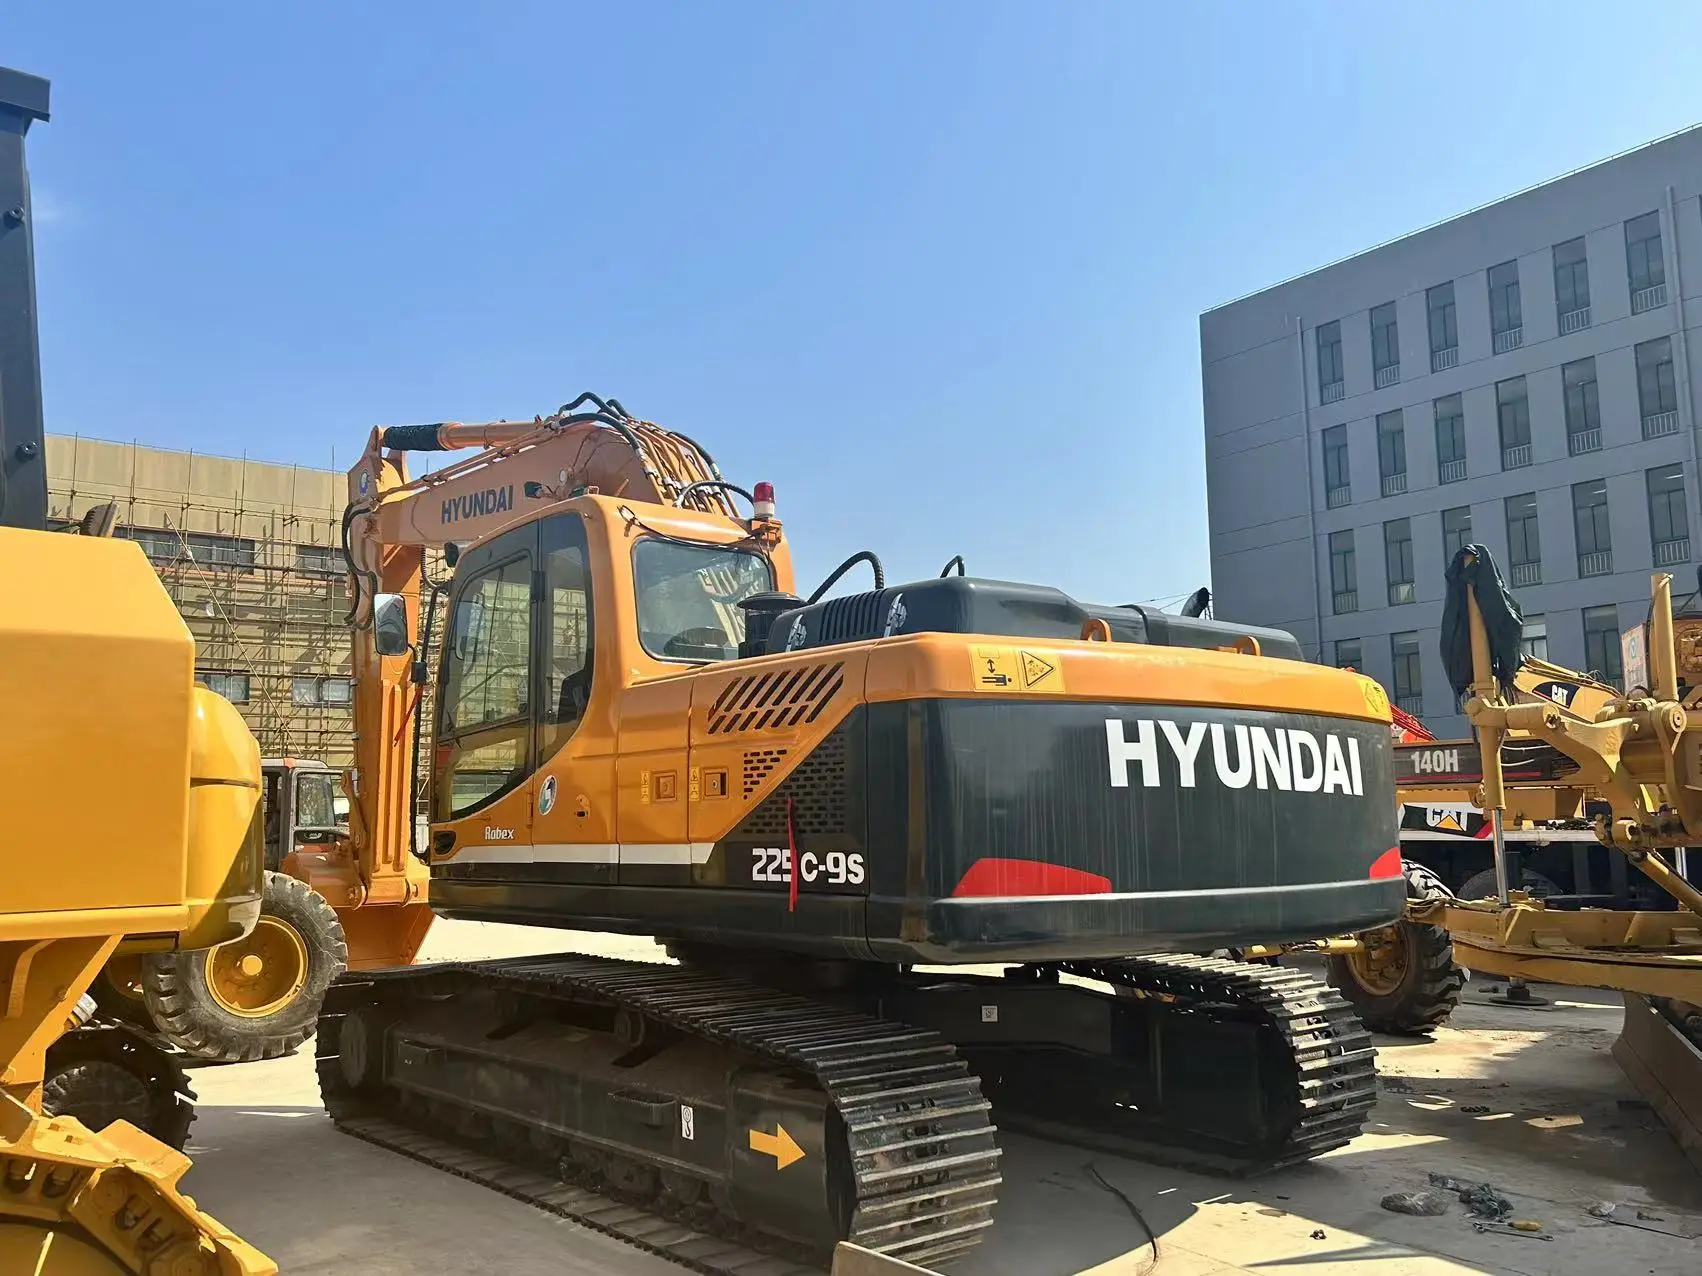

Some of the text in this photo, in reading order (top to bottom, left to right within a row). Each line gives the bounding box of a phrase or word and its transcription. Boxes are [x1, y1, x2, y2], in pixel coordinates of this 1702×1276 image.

[441, 484, 513, 524] HYUNDAI
[1551, 684, 1568, 706] CAT
[1105, 719, 1364, 796] HYUNDAI
[1411, 749, 1459, 773] 140H
[1426, 807, 1468, 831] CAT
[485, 826, 514, 840] Robex
